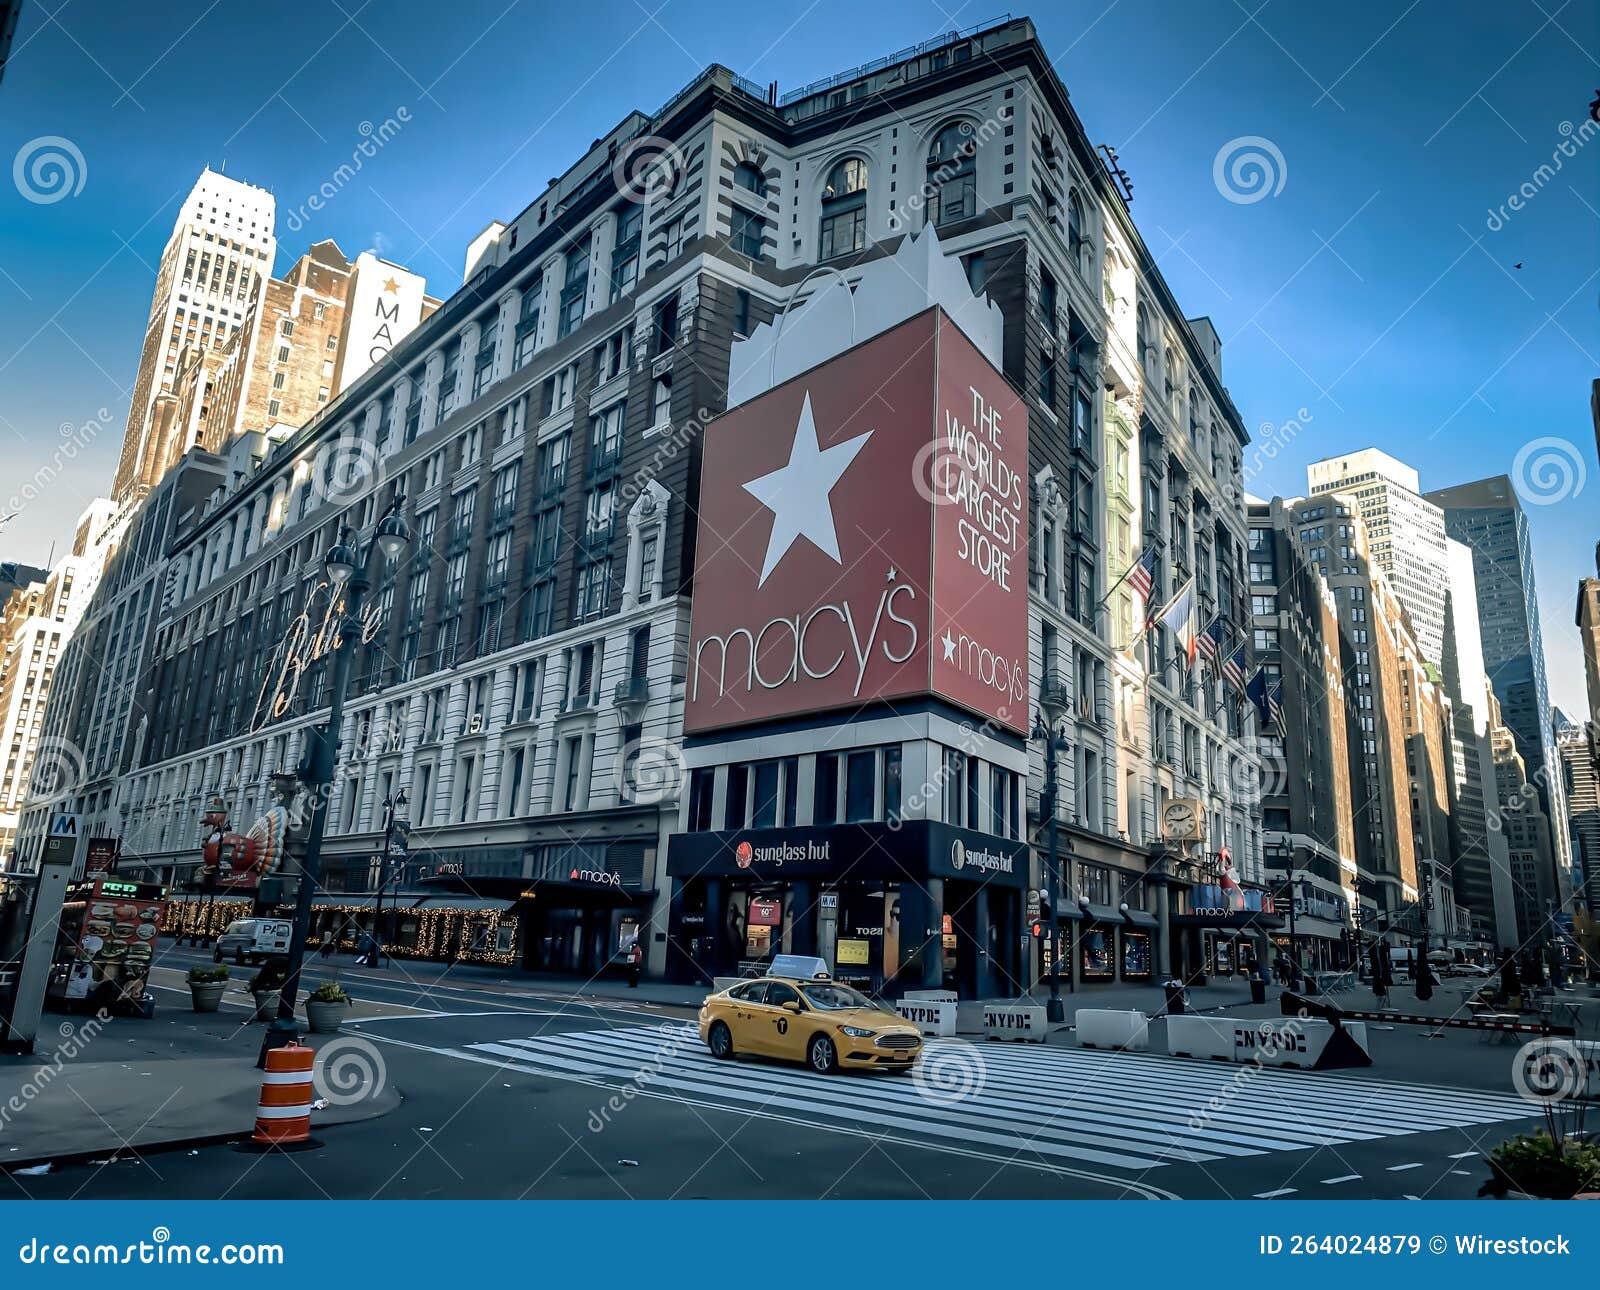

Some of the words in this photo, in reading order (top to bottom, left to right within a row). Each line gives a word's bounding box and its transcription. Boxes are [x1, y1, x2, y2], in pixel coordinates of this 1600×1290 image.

[969, 385, 1001, 450] THE
[946, 409, 1022, 511] WORLD'S
[945, 457, 1020, 551] LARGEST
[958, 519, 1011, 592] STORE
[250, 582, 383, 736] Beliee
[693, 566, 917, 702] macy's
[958, 633, 1023, 704] macy's
[754, 841, 806, 867] sunglass
[808, 840, 830, 860] hut
[965, 847, 999, 873] sunglass
[1000, 851, 1012, 873] hut
[901, 1007, 935, 1023] NYPD
[988, 1013, 1024, 1029] NYPD
